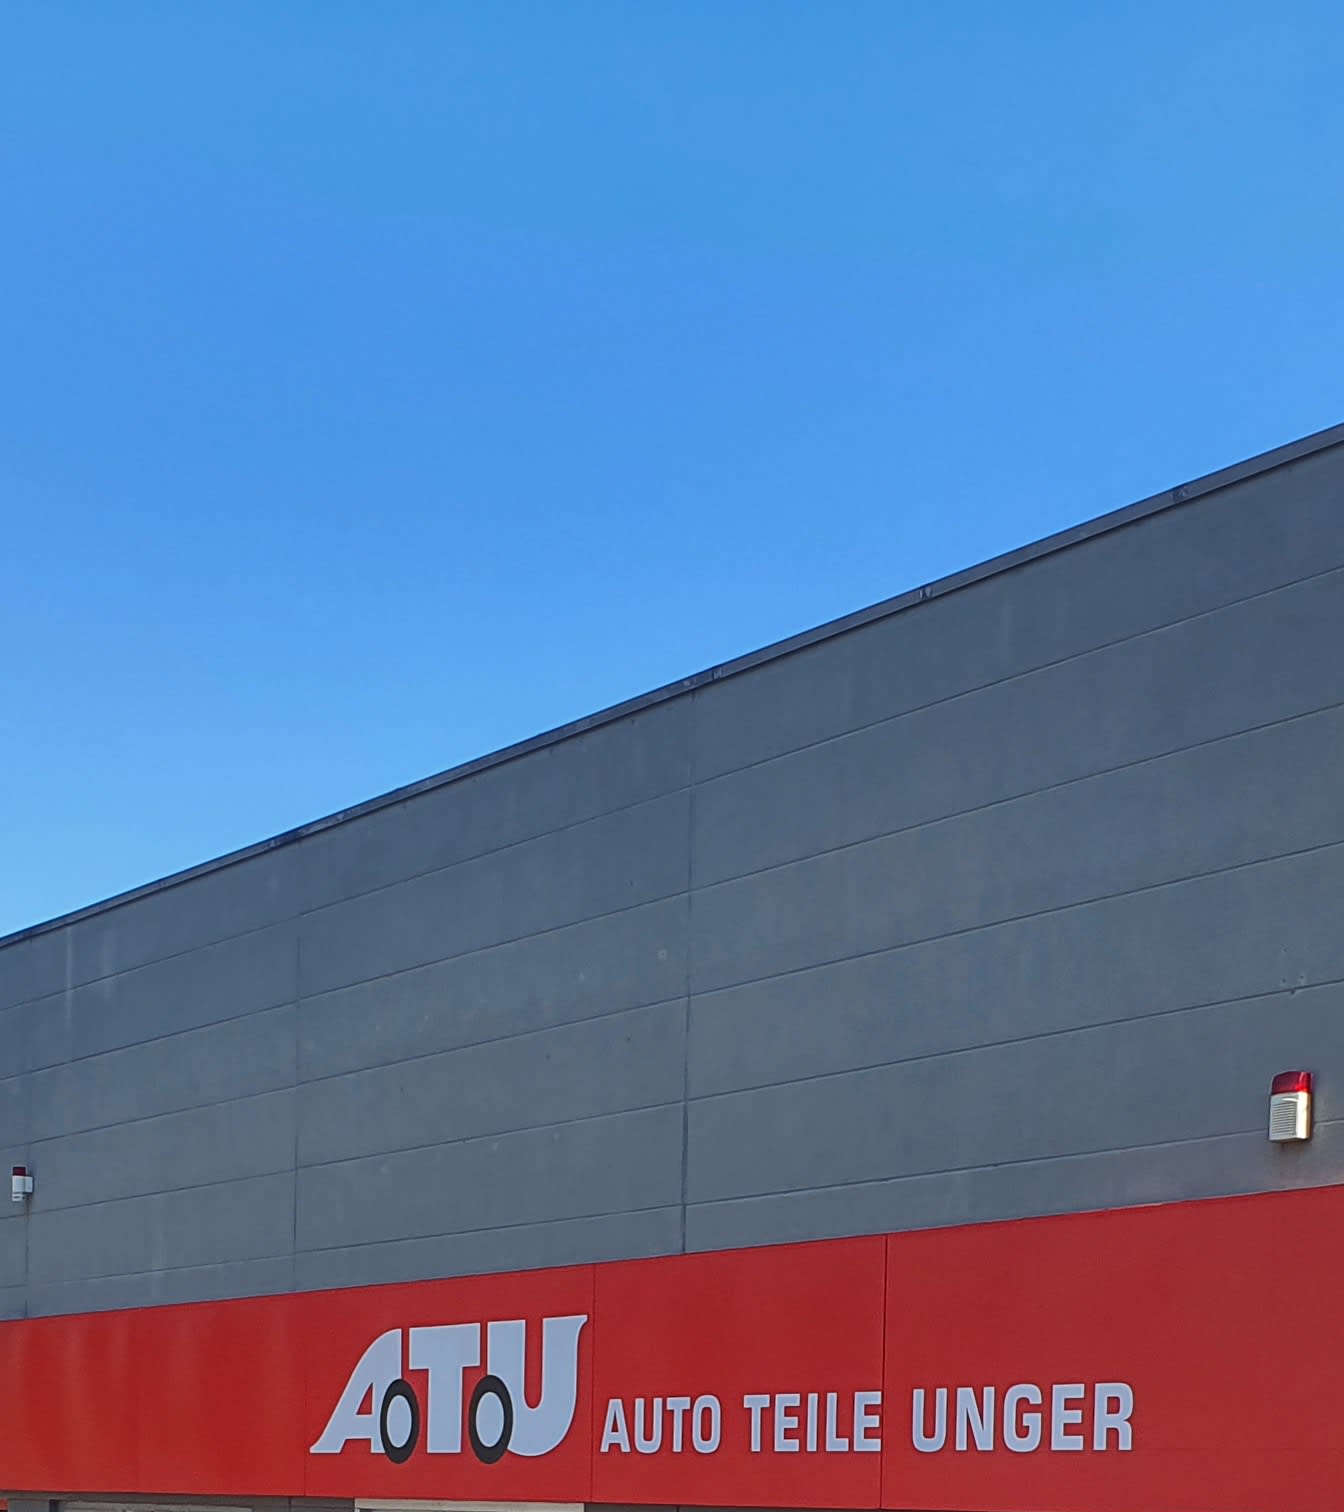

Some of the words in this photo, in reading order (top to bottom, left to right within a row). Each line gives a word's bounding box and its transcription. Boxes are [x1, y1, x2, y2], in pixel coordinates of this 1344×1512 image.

[309, 1314, 587, 1464] ATU
[600, 1394, 722, 1454] AUTO
[743, 1391, 882, 1453] TEILE
[912, 1382, 1134, 1453] UNGER
